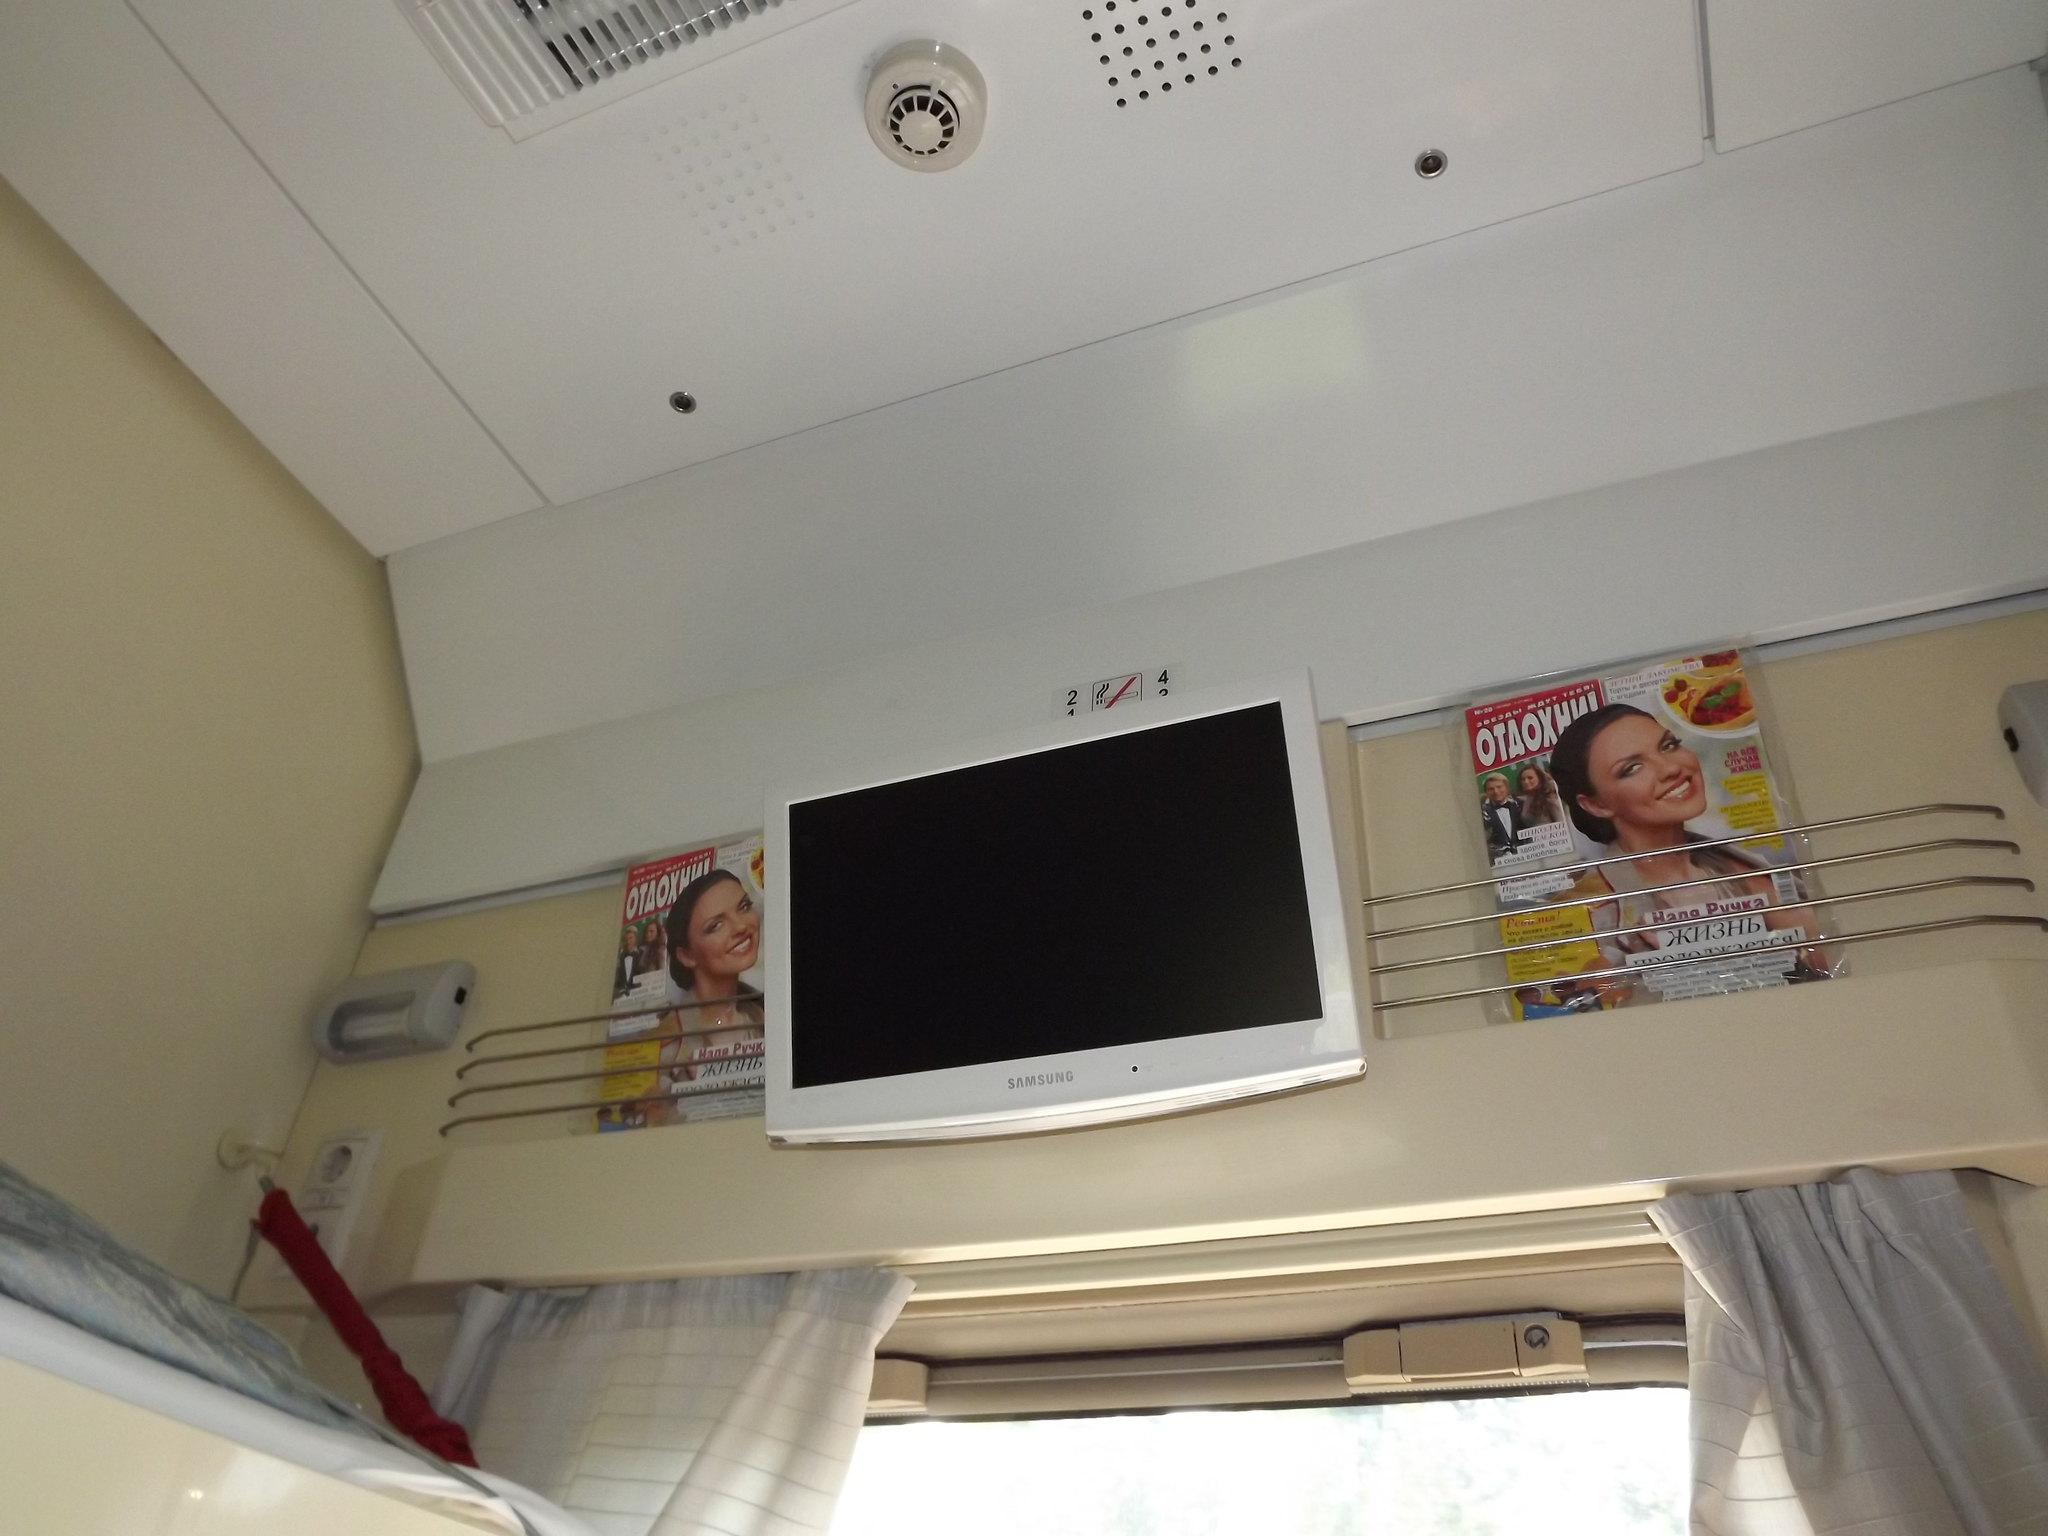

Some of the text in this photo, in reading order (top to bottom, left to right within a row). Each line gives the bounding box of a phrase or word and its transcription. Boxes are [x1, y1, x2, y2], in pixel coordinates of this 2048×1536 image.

[1157, 669, 1169, 685] 4
[1066, 689, 1078, 706] 2
[1476, 708, 1522, 728] ЗВЕЗДЫ
[1527, 695, 1558, 711] ЖДУТ
[1562, 683, 1595, 698] ТЕБЯ!
[1476, 690, 1599, 767] ОТДОХНИ!
[1504, 855, 1525, 865] снова
[626, 857, 711, 920] ОТДОХНИ!
[1666, 917, 1761, 948] ЖИЗНЬ
[733, 1041, 765, 1055] Ручк
[701, 1057, 763, 1078] ЖИЗНЬ
[1007, 1070, 1074, 1090] SAMSUNG
